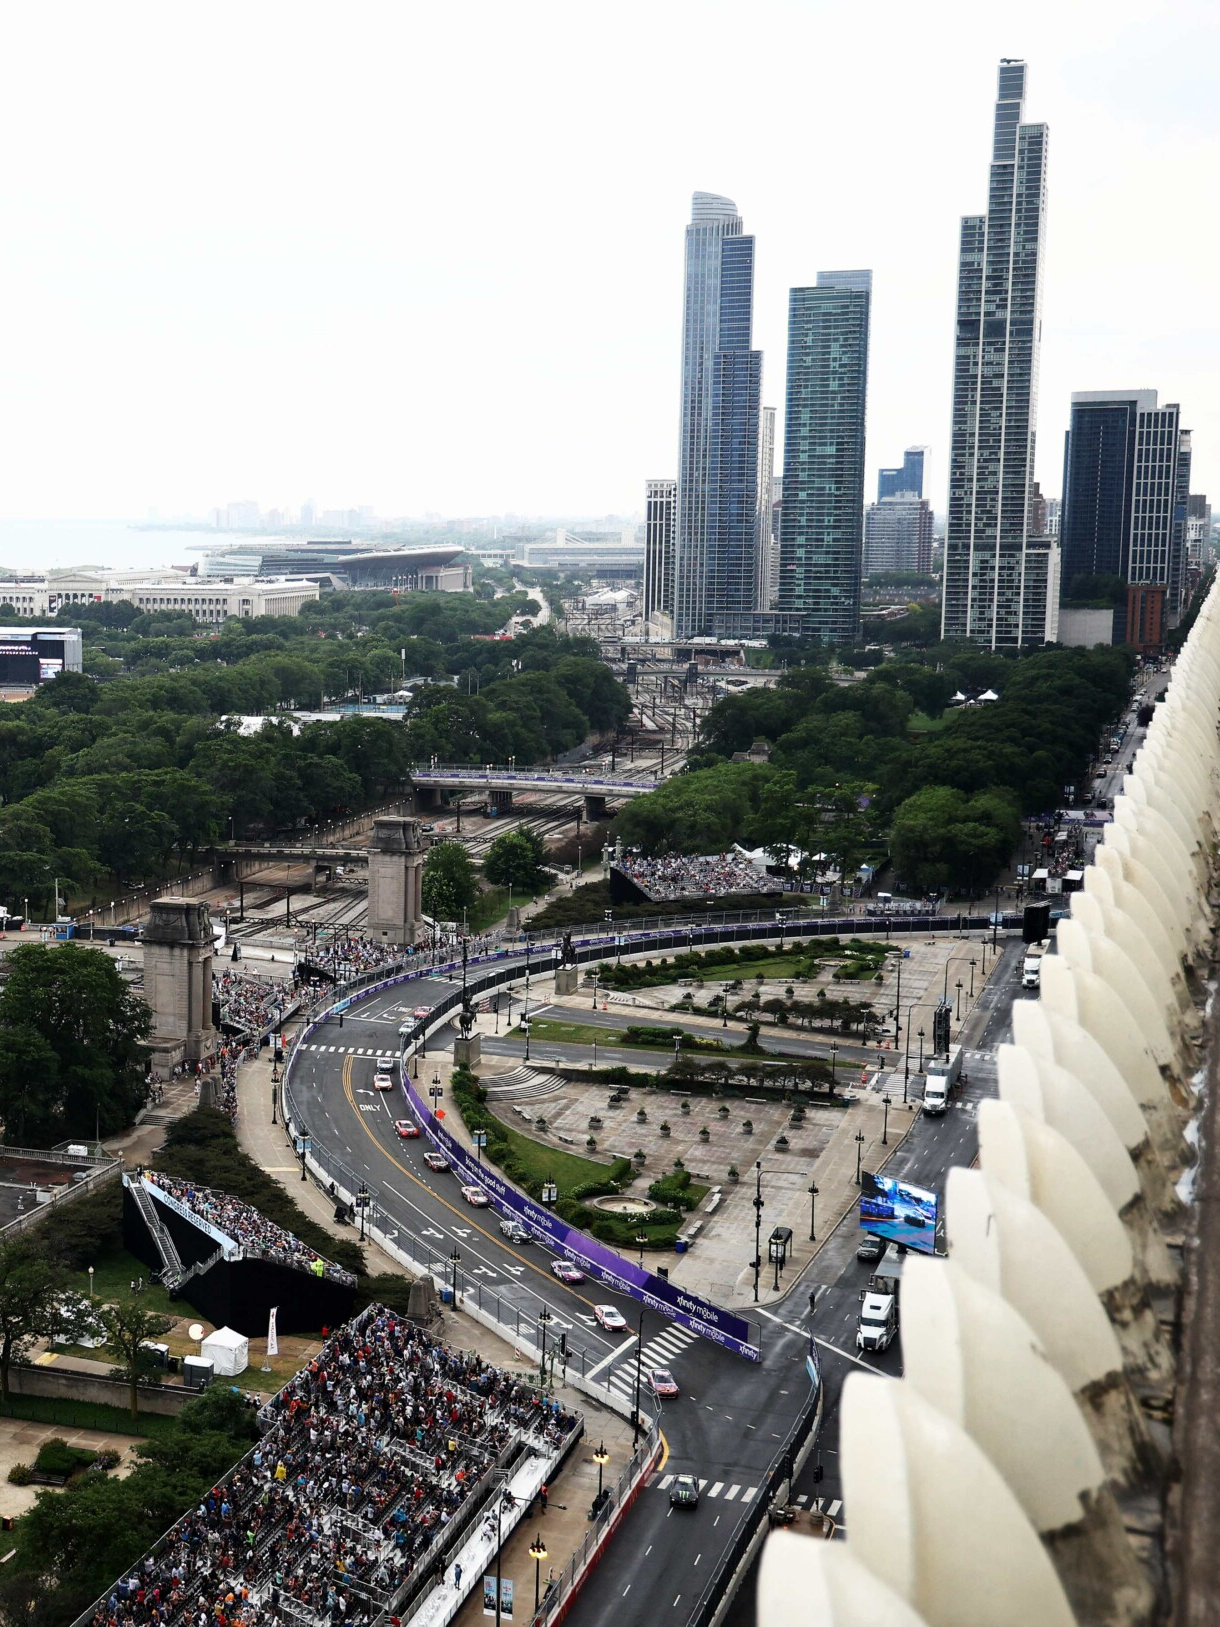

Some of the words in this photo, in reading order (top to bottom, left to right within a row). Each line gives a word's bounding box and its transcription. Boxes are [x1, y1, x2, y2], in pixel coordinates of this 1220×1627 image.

[359, 1104, 381, 1112] ONLY
[484, 1176, 496, 1188] good
[496, 1184, 506, 1196] stuff
[164, 1194, 188, 1218] CONGRESS
[188, 1211, 212, 1234] RESERVED
[524, 1205, 537, 1220] xfinity
[536, 1214, 552, 1229] mobile
[530, 1226, 542, 1239] xfinity
[541, 1234, 554, 1246] mobile
[564, 1248, 576, 1262] xfinity
[576, 1256, 590, 1269] mobile
[601, 1270, 616, 1284] xfinity
[614, 1279, 631, 1293] mobile
[642, 1294, 658, 1308] xfinity
[658, 1303, 676, 1318] mobile
[676, 1296, 696, 1312] xfinity
[696, 1306, 718, 1322] mobile
[689, 1320, 706, 1334] xfinity
[706, 1328, 725, 1342] mobile
[739, 1344, 758, 1360] xfinity
